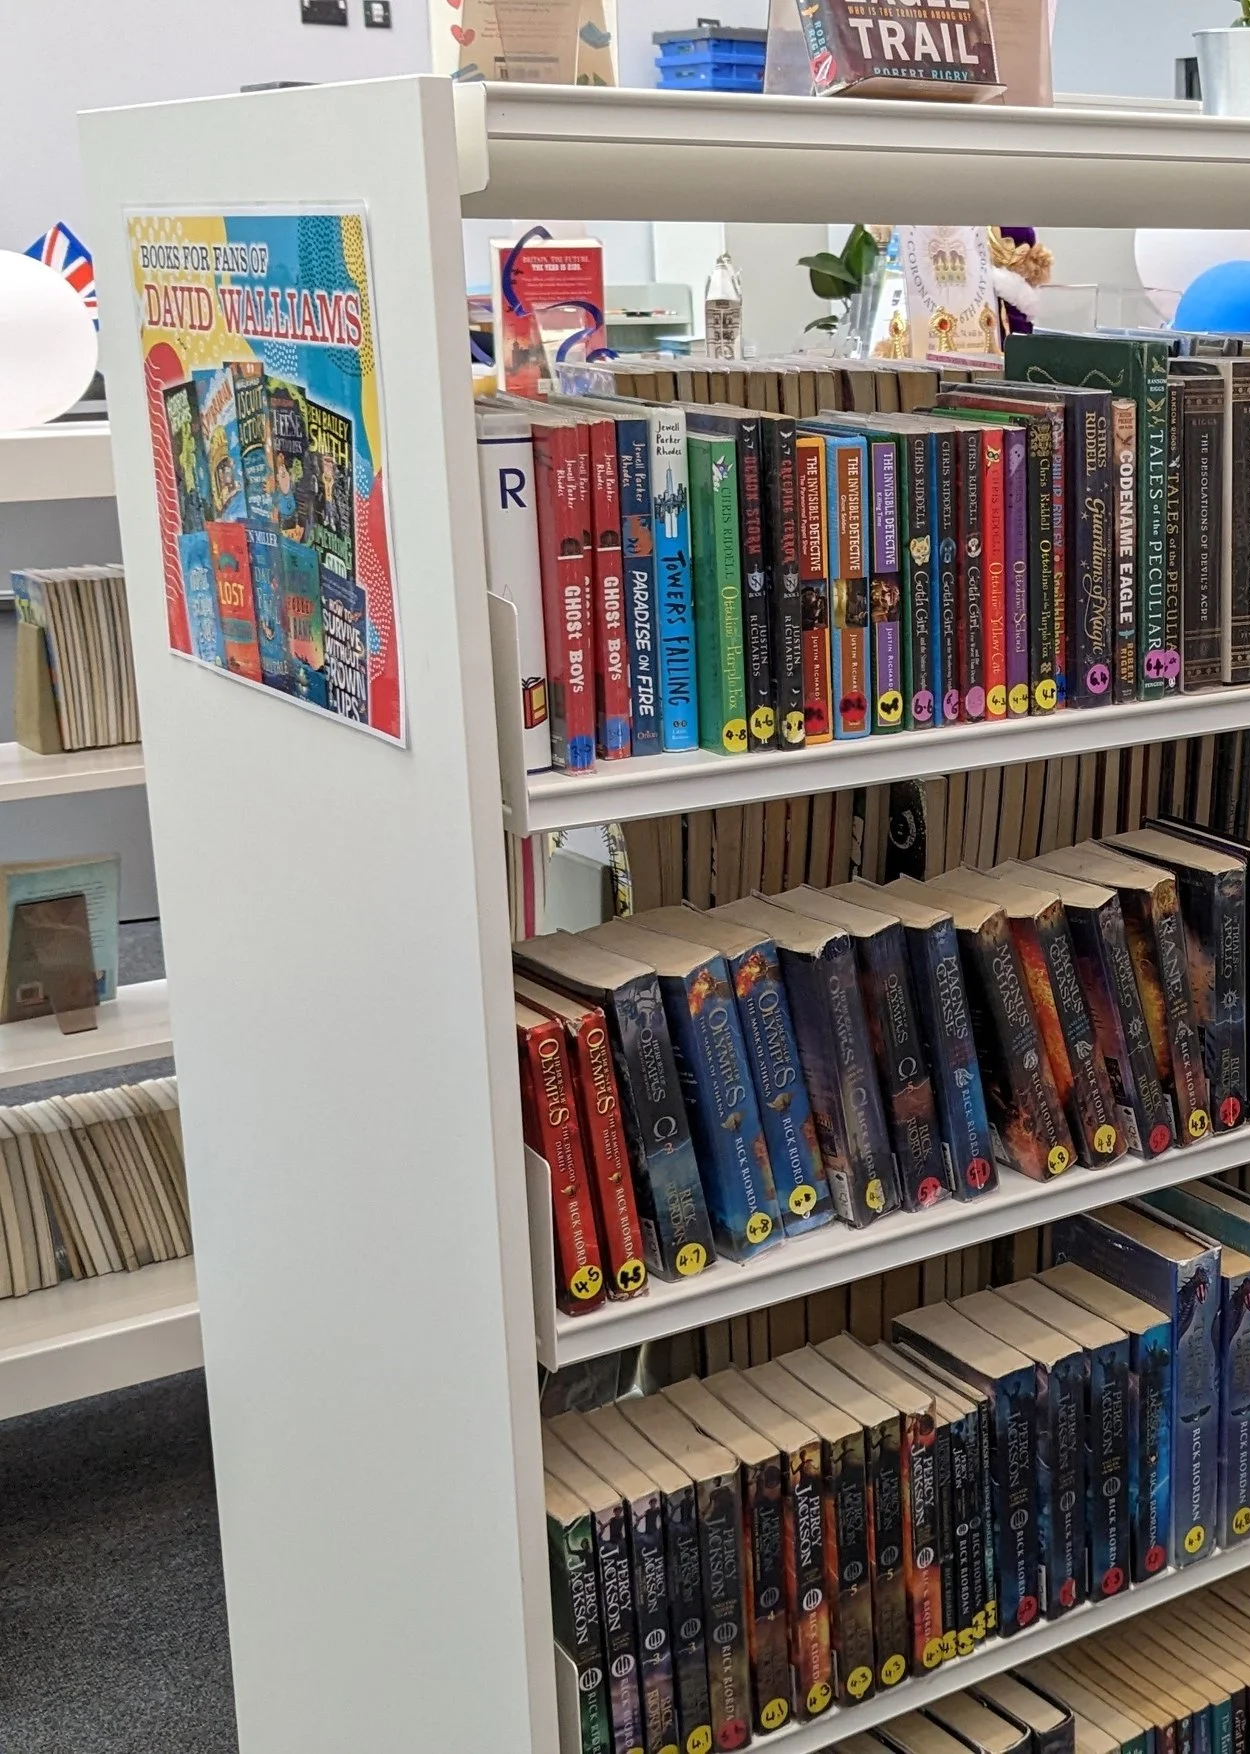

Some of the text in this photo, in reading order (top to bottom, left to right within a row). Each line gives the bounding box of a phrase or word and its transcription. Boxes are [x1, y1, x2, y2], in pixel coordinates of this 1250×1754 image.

[848, 18, 979, 64] TRAIL
[140, 246, 267, 274] BOOKS FOR FANS OF
[144, 284, 362, 346] DAVID WALLIAMS
[656, 421, 680, 432] Jewell
[656, 434, 681, 446] Parker
[656, 446, 682, 457] Rhodes
[1085, 411, 1097, 477] RIDDELL
[1097, 416, 1107, 468] CHRIS
[499, 468, 528, 510] R
[807, 456, 821, 572] THE INVISIBLE DETECTIVE
[848, 456, 860, 571] THE INVISIBLE DETECTIVE
[883, 452, 895, 565] THE INVISIBLE DETECTIVE
[915, 439, 926, 529] CHRIS RIDDELL
[1200, 457, 1209, 532] DESOLATIONS
[1119, 451, 1134, 624] CODENAME EAGLE
[1148, 430, 1164, 650] TALES of the PECULIAR
[219, 582, 245, 608] LOST
[603, 576, 622, 681] GHOST BOYS
[662, 551, 691, 707] TOWERS FALLING
[1200, 599, 1208, 622] ACRE
[564, 585, 585, 694] GHOST BOYS
[632, 569, 654, 716] PARADISE ON FIRE
[750, 615, 760, 677] RICHARDS
[759, 625, 768, 665] JUSTIN
[784, 616, 794, 677] RICHARDS
[812, 636, 820, 660] JUSTIN
[1126, 642, 1134, 684] ROBERT
[991, 957, 1017, 1027] CHASE
[996, 943, 1031, 1029] MAGNUS
[1049, 942, 1073, 1012] CHASE
[1054, 933, 1085, 1015] MAGNUS
[1159, 917, 1183, 1001] KANE
[936, 962, 954, 1037] CHASE
[942, 955, 968, 1040] MAGNUS
[586, 1027, 616, 1114] OLYMPUS
[709, 1007, 746, 1108] OLYMPUS
[757, 988, 796, 1089] OLYMPUS
[538, 1038, 569, 1127] OLYMPUS
[781, 1116, 795, 1146] RICK
[910, 1444, 925, 1527] JACKSON
[922, 1455, 934, 1508] PERCY
[1190, 1426, 1203, 1522] RICK RIORDAN
[795, 1483, 812, 1568] JACKSON
[809, 1495, 823, 1548] PERCY
[567, 1557, 590, 1645] JACKSON
[583, 1570, 599, 1626] PERCY
[600, 1545, 621, 1632] JACKSON
[615, 1558, 632, 1612] PERCY
